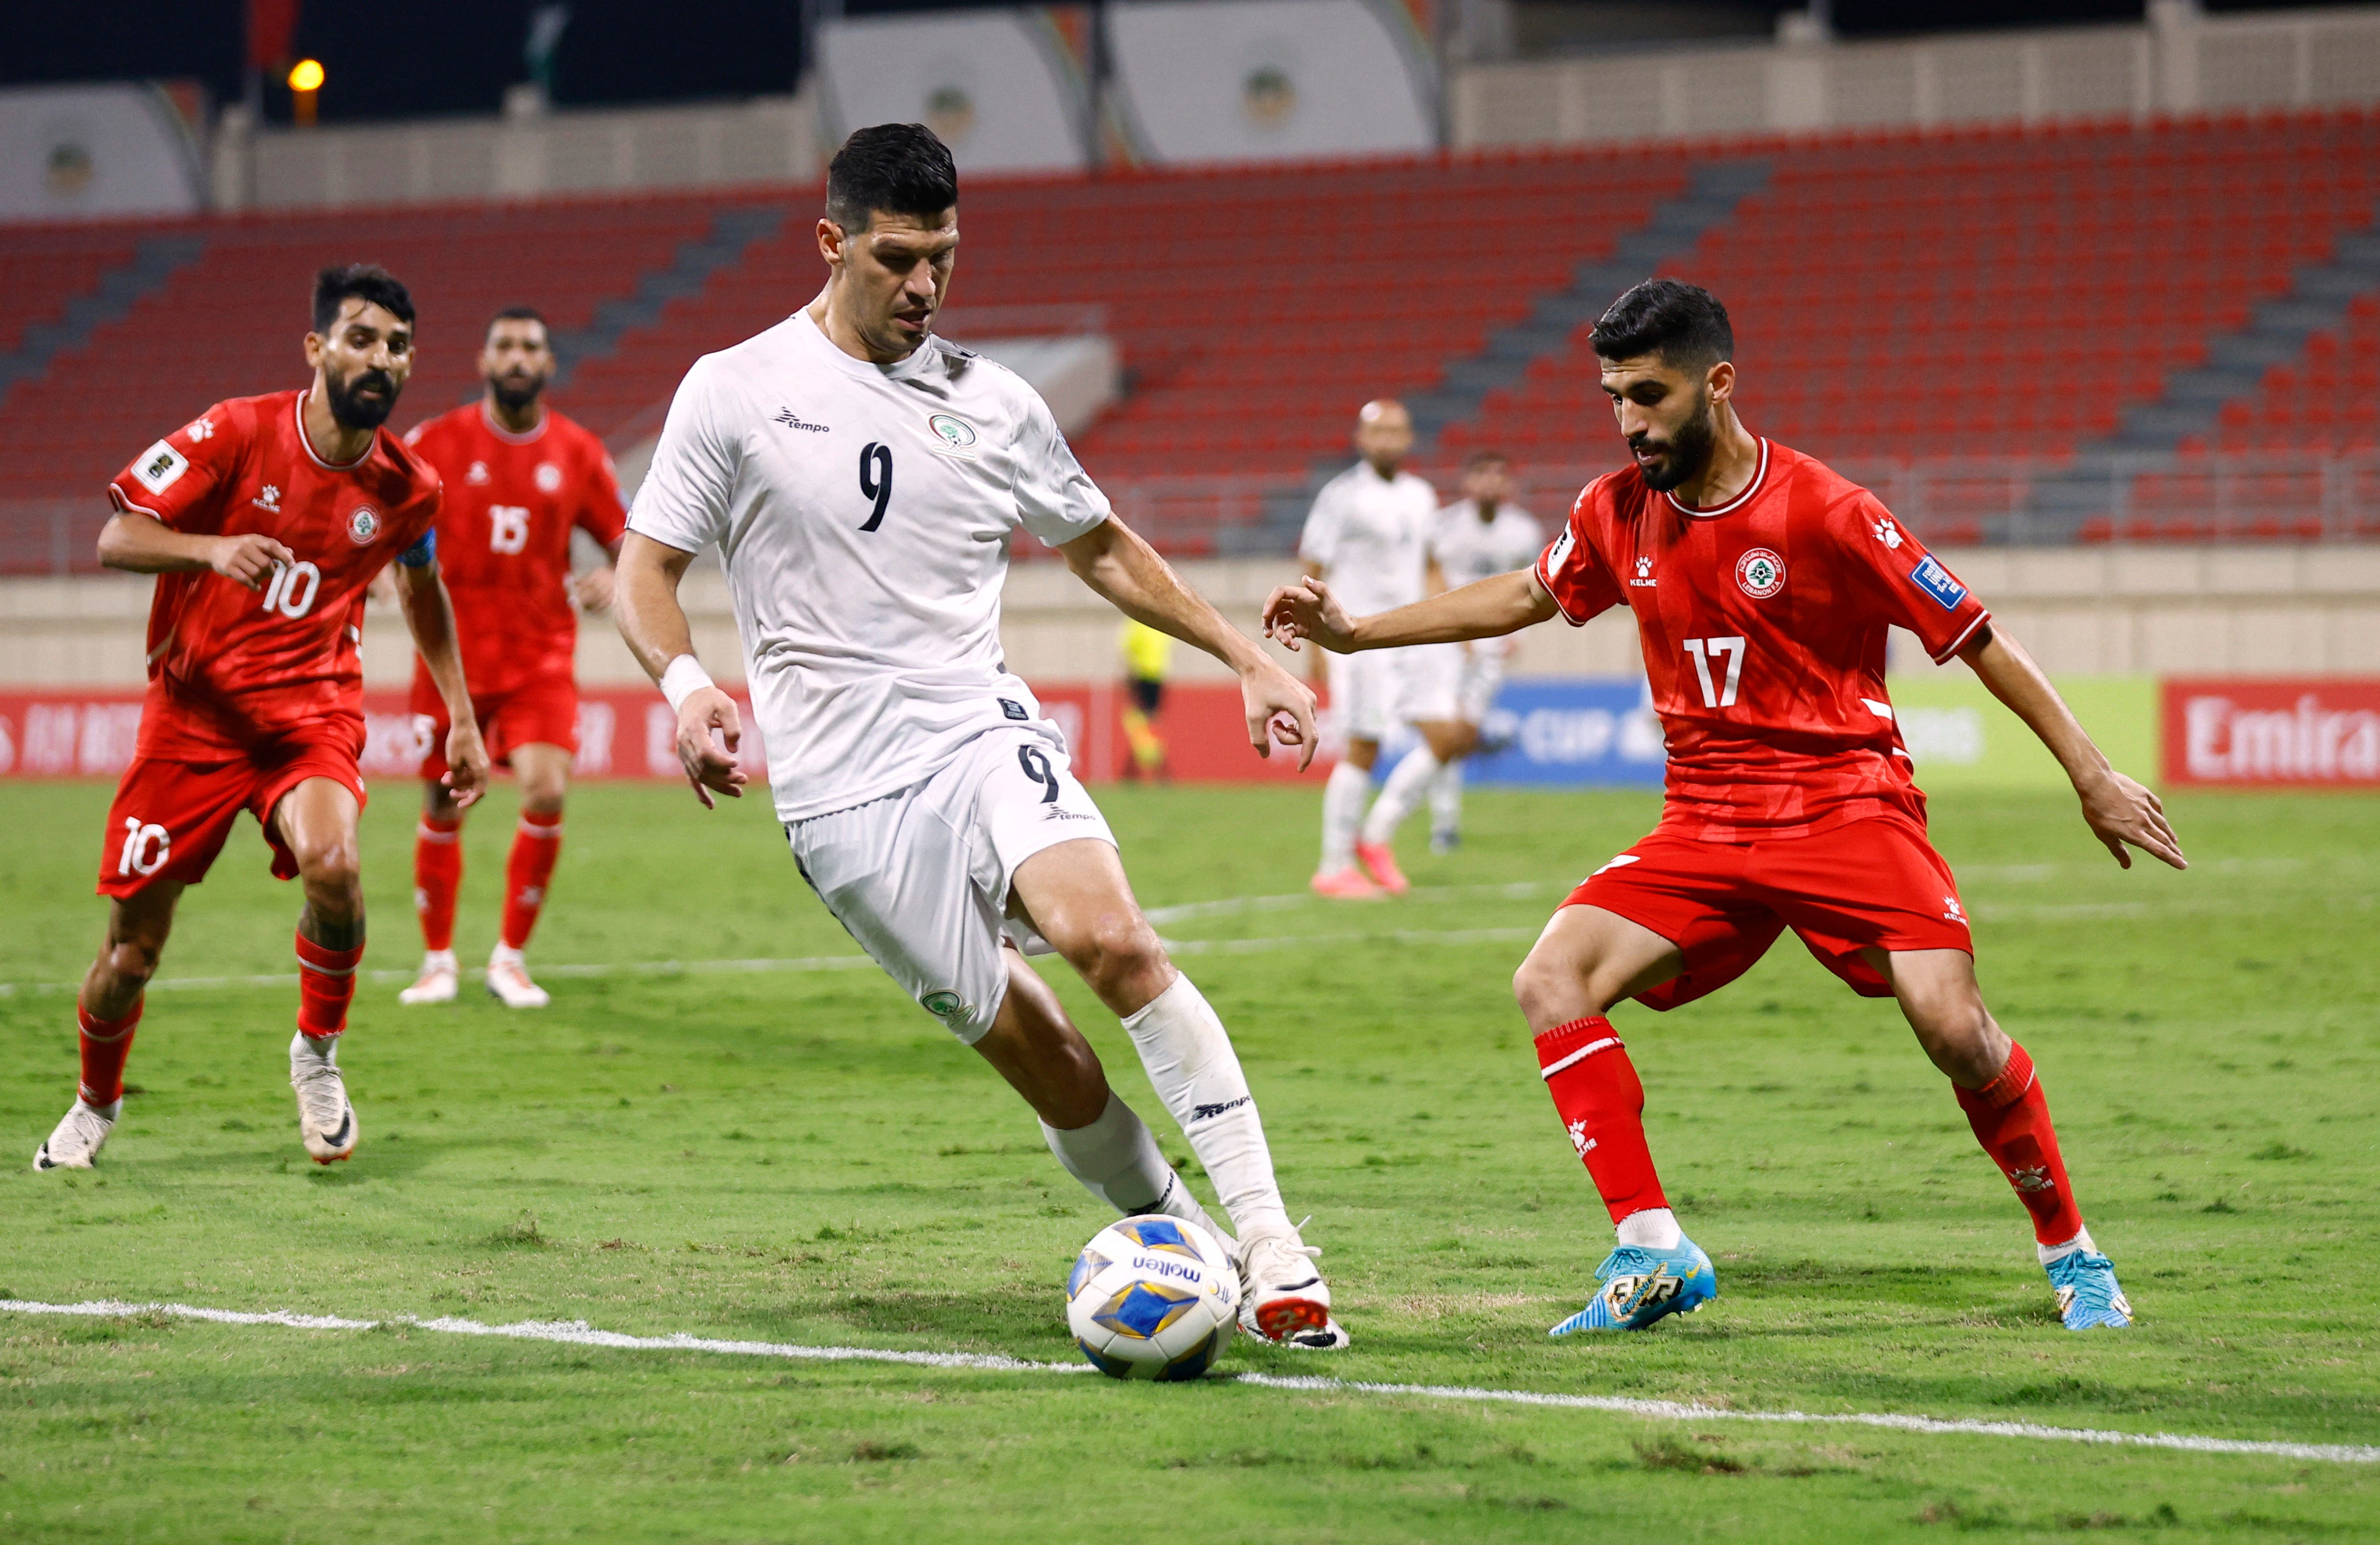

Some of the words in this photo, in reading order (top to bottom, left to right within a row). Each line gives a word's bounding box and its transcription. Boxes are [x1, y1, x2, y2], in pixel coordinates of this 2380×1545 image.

[788, 420, 830, 433] tempo
[858, 442, 893, 532] 9
[490, 504, 530, 555] 15
[262, 559, 321, 620] 10
[1630, 579, 1657, 587] KELME
[1742, 581, 1772, 595] LEBANON
[1683, 636, 1745, 708] 17
[1017, 744, 1059, 804] 9
[1060, 812, 1096, 821] tempo
[118, 816, 170, 876] 10
[1133, 1256, 1200, 1283] molten
